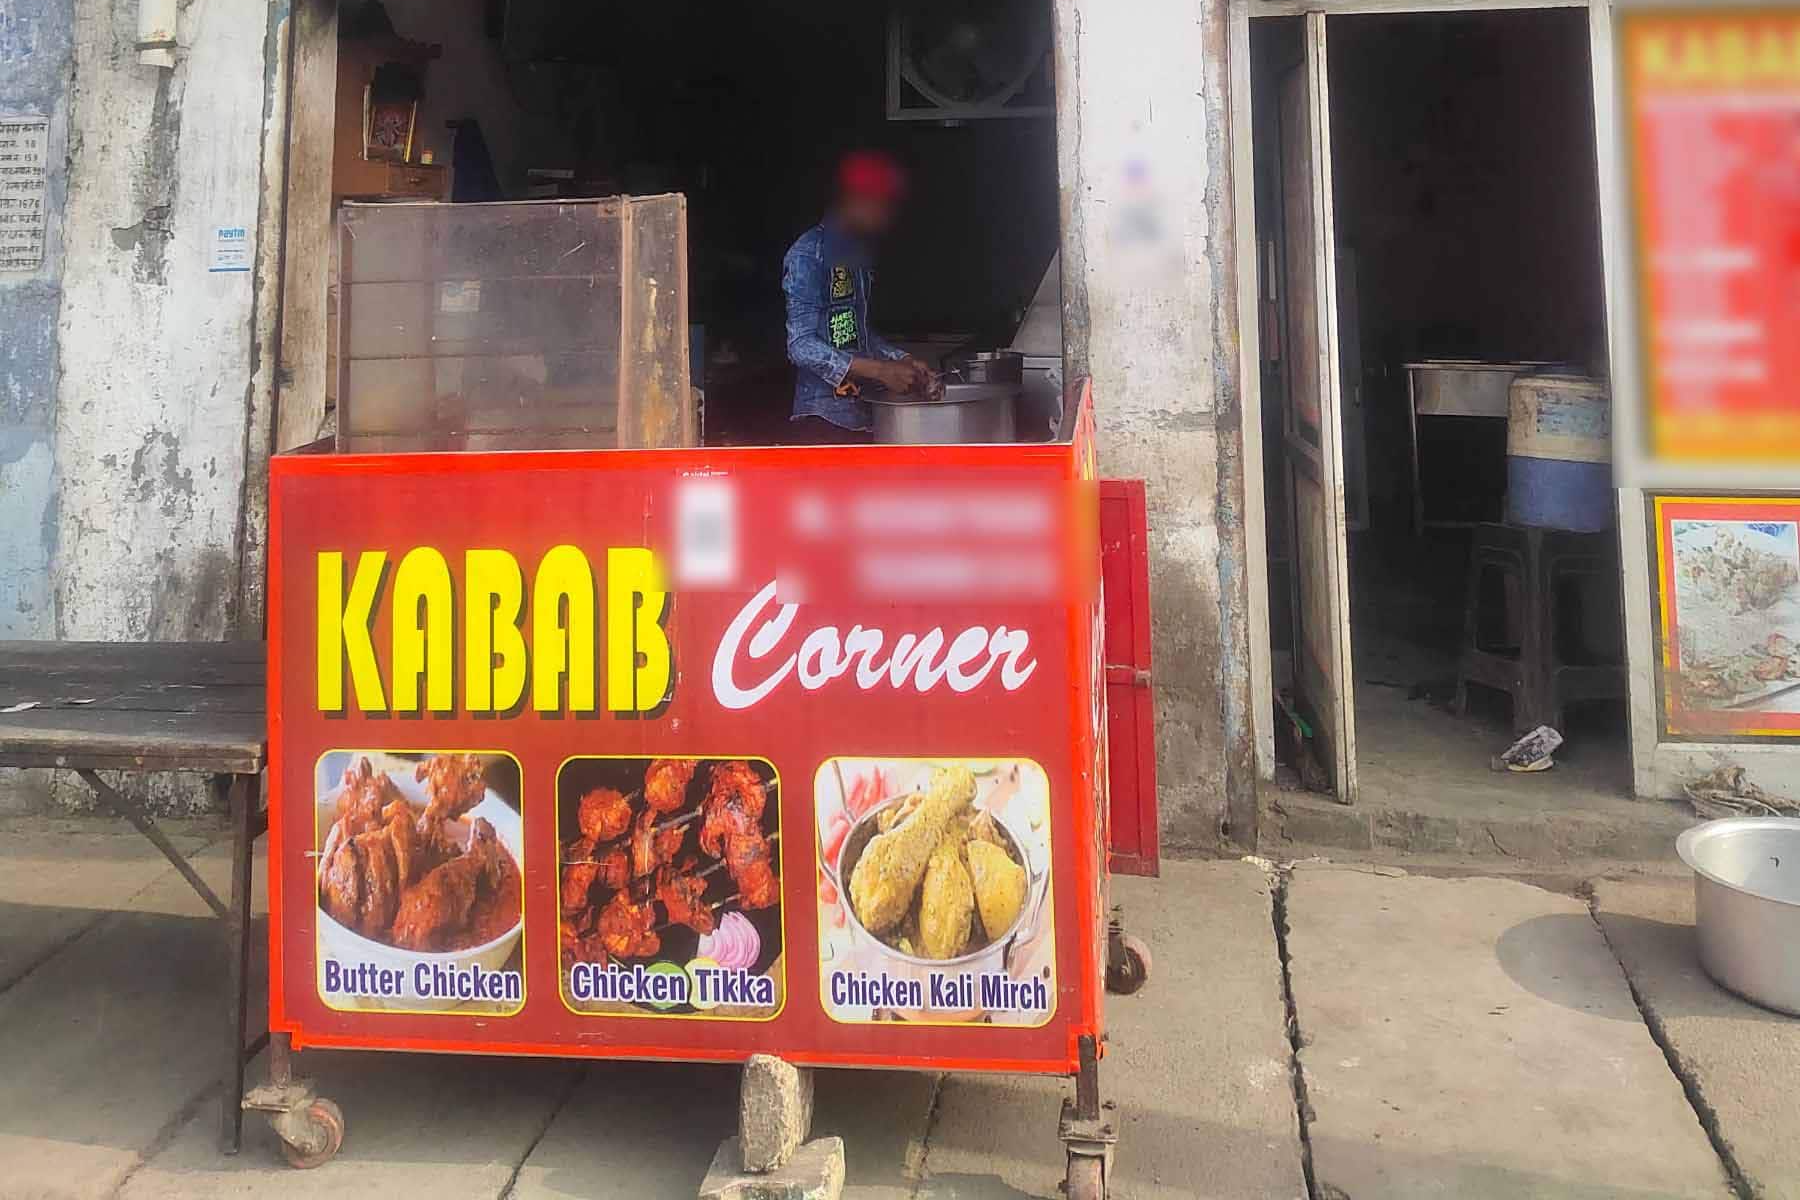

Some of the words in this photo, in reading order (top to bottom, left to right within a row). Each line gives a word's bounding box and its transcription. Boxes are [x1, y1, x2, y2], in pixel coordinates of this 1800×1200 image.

[317, 544, 674, 713] KABAB
[712, 579, 1038, 710] Corner
[324, 959, 405, 995] Butter
[413, 962, 521, 1000] Chicken
[571, 963, 688, 1003] Chicken
[694, 968, 775, 1005] Tikka
[830, 970, 923, 1007] Chicken
[929, 972, 974, 1008] Kali
[980, 973, 1048, 1010] Mirch
